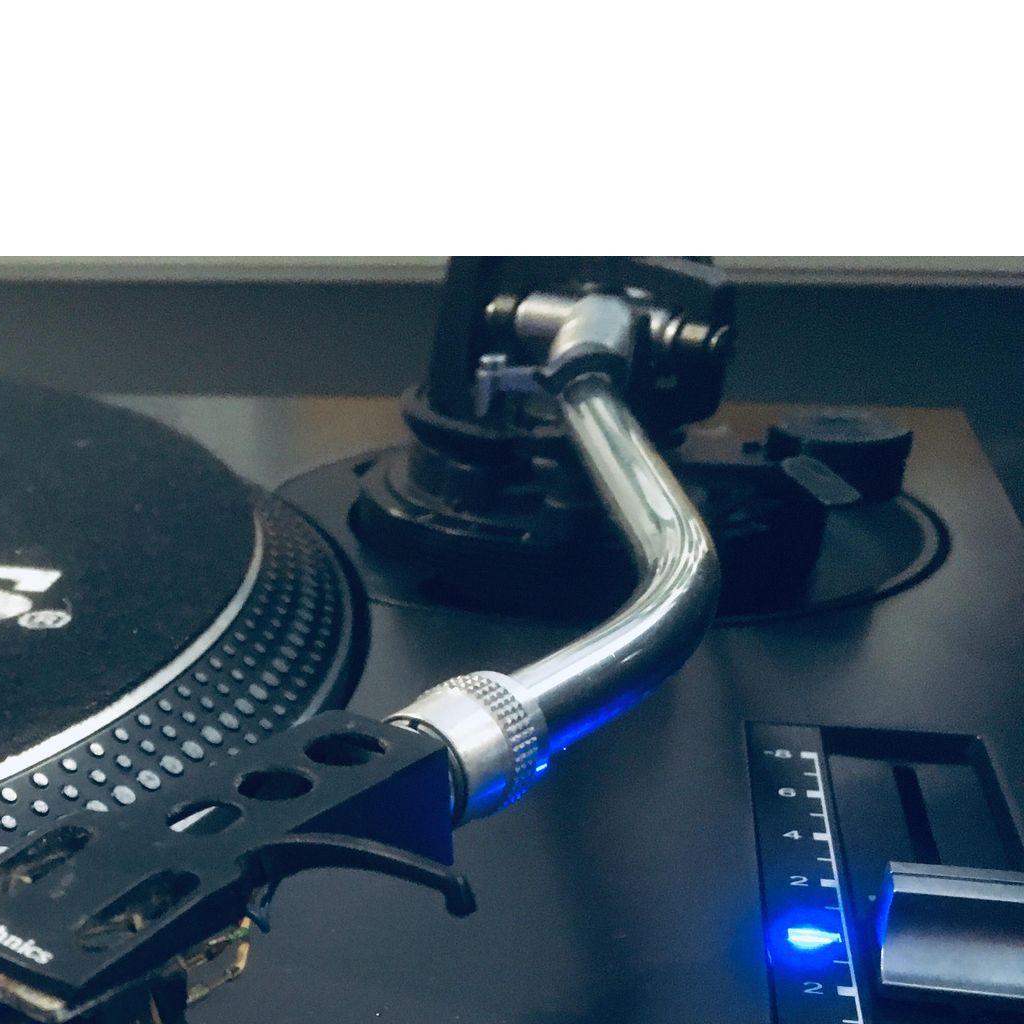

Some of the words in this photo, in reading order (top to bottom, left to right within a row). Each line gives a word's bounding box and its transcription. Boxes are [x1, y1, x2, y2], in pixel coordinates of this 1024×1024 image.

[782, 830, 802, 840] 4
[790, 875, 809, 887] 2
[803, 981, 824, 995] 2
